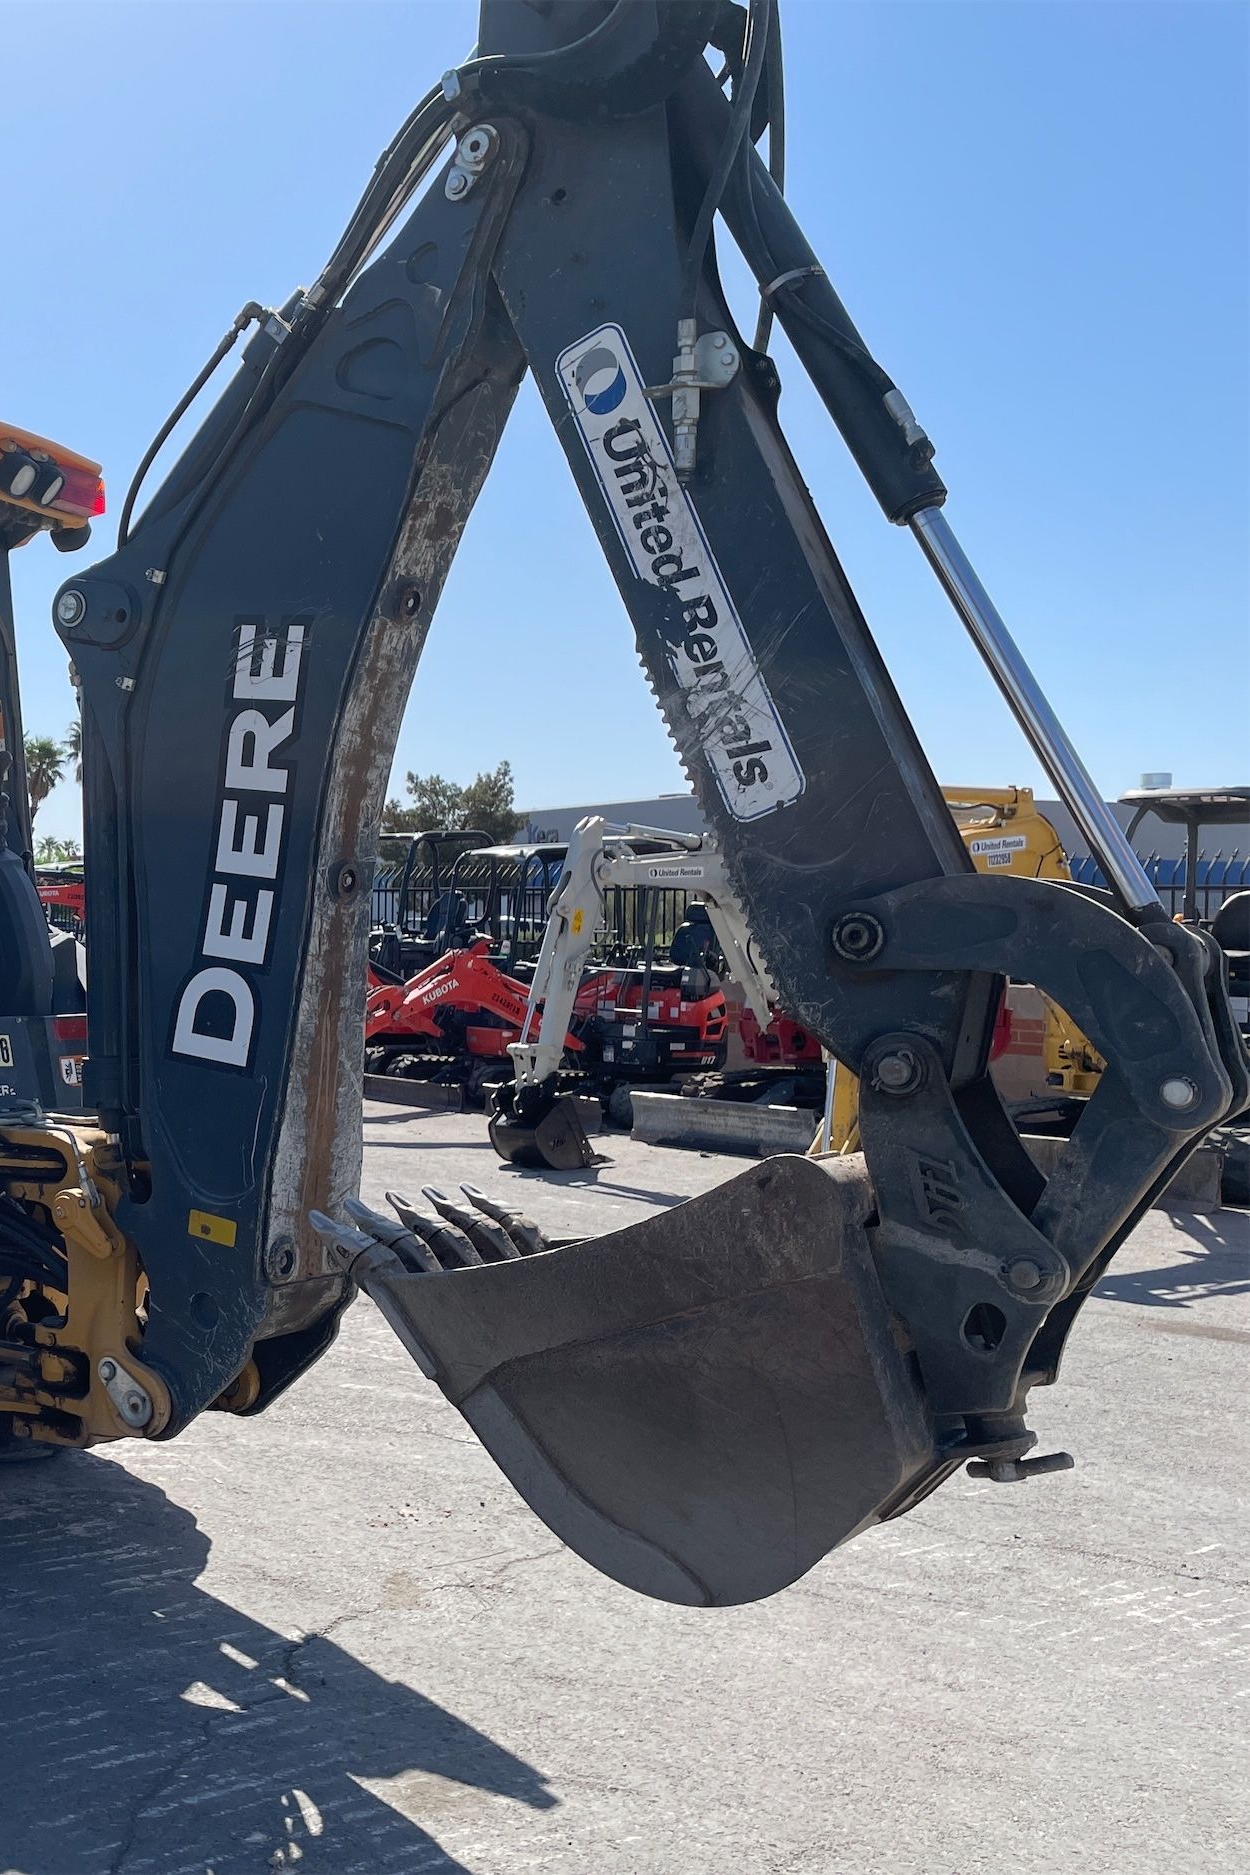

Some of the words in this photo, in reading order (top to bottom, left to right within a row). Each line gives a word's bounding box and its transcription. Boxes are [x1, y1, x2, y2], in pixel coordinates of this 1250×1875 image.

[602, 418, 700, 588] United
[171, 624, 306, 1068] DEERE
[658, 868, 679, 877] United
[680, 868, 702, 877] Rentals
[422, 978, 459, 1006] KUBOTA
